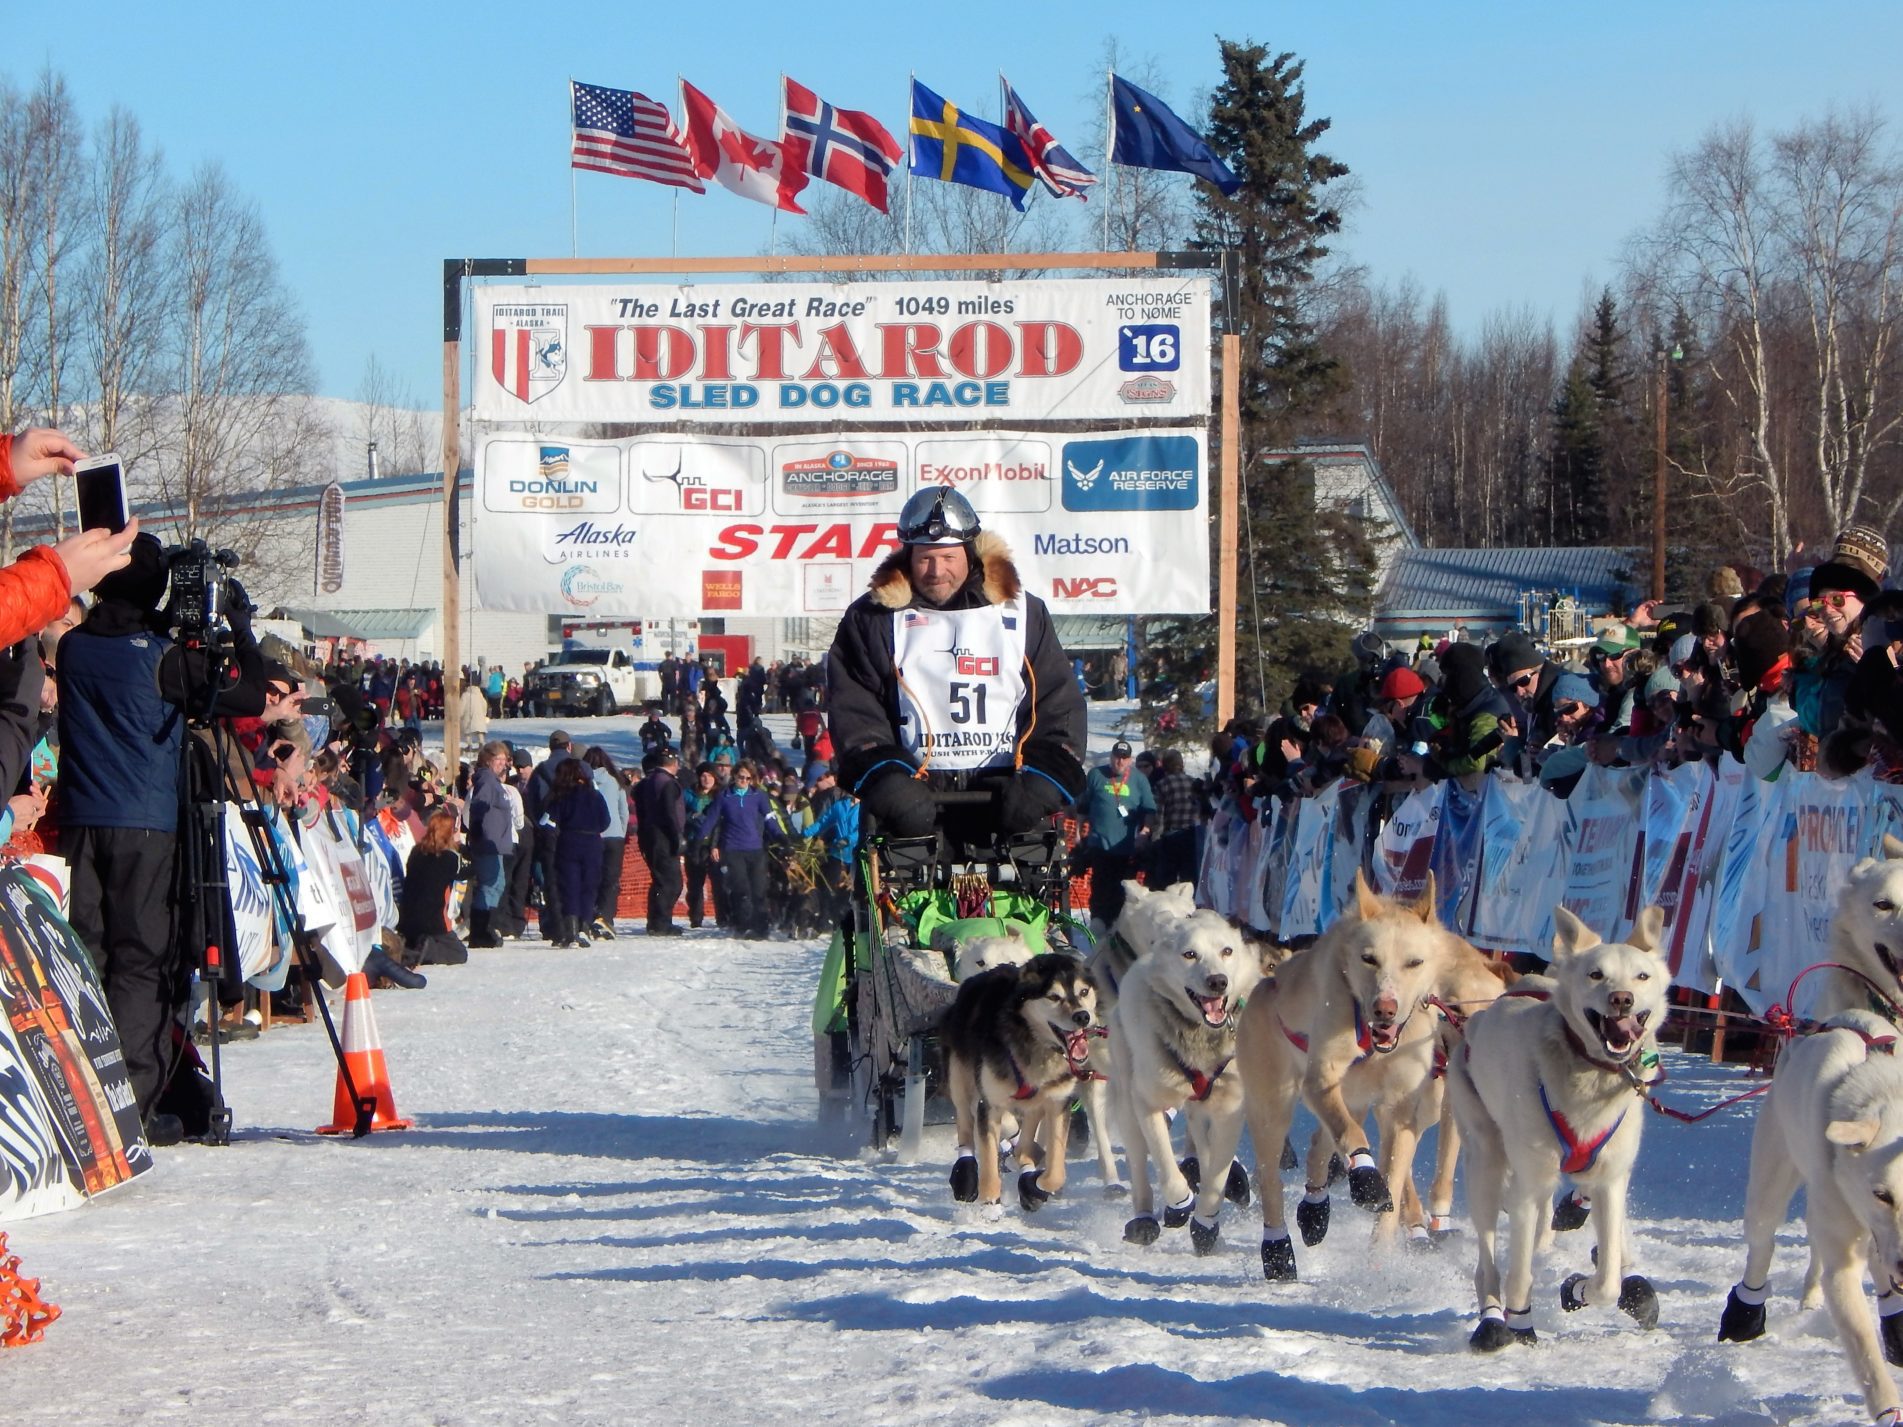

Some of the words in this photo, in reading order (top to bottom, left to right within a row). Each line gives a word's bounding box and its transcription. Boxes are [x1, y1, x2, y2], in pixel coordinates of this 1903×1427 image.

[895, 296, 950, 316] 1049
[957, 294, 1015, 316] miles
[1106, 293, 1192, 306] ANCHORAGE
[496, 308, 537, 317] IDITAROD
[541, 308, 565, 317] TRAIL
[670, 297, 719, 319] Last
[730, 297, 794, 319] Great
[1117, 307, 1135, 320] TO
[1141, 306, 1182, 320] NOME
[516, 319, 544, 328] ALASKA
[584, 319, 1085, 382] IDITAROD
[649, 383, 759, 409] SLED
[779, 381, 872, 409] DOG
[891, 380, 1011, 408] RACE
[787, 471, 894, 482] ANCHORAGE
[920, 463, 1046, 487] ExxonMobil
[1109, 471, 1137, 481] AIR
[1140, 470, 1193, 480] FORCE
[509, 480, 598, 494] DONLIN
[1114, 480, 1188, 490] RESERVE
[522, 496, 584, 509] GOLD
[683, 487, 743, 511] GCI
[555, 521, 637, 547] Alaska
[1034, 533, 1129, 555] Matson
[560, 550, 630, 558] AIRLINES
[577, 581, 605, 591] Bristol
[606, 581, 625, 593] Bay
[706, 582, 741, 591] WELLS
[1052, 577, 1118, 598] NAC
[706, 590, 741, 599] FARGO
[957, 656, 1000, 676] GCI
[949, 682, 987, 725] 51
[918, 731, 993, 748] IDITAROD
[952, 749, 978, 757] WITH
